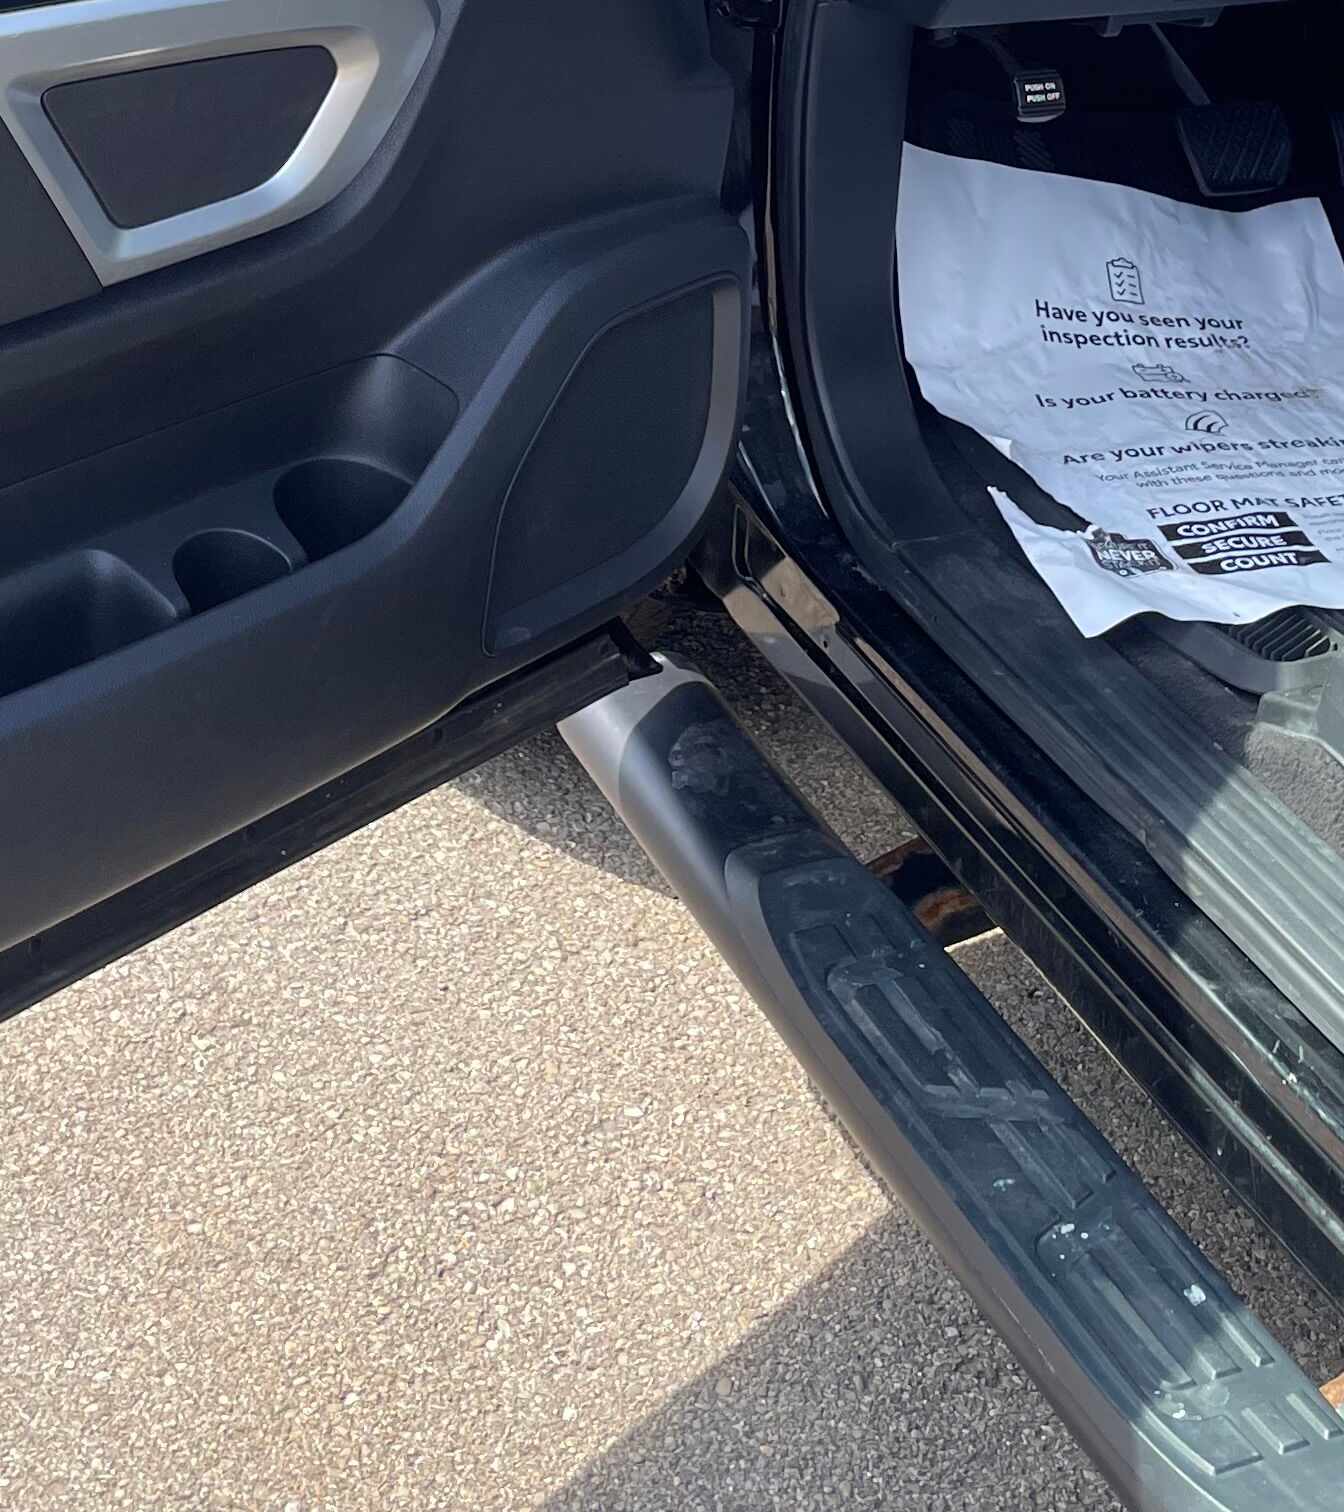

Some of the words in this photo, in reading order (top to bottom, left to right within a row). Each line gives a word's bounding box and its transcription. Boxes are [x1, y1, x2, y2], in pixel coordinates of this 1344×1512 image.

[1035, 299, 1087, 322] Have
[1092, 309, 1134, 327] you
[1139, 314, 1190, 328] seen
[1193, 316, 1243, 330] your
[1040, 324, 1160, 349] inspection
[1164, 334, 1250, 349] results?
[1035, 393, 1057, 408] Is
[1060, 391, 1115, 409] your
[1118, 387, 1207, 402] battery
[1063, 450, 1105, 465] Are
[1110, 444, 1164, 462] your
[1170, 441, 1254, 454] wipers
[1096, 472, 1129, 483] Your
[1134, 462, 1198, 479] Assistant
[1201, 461, 1254, 472] Service
[1255, 458, 1317, 469] Manager
[1136, 479, 1169, 489] with
[1170, 473, 1213, 486] these
[1216, 470, 1287, 481] questions
[1288, 469, 1316, 477] and
[1146, 499, 1228, 519] FLOOR
[1231, 496, 1279, 509] MAT
[1176, 514, 1280, 537] CONFIRM
[1096, 549, 1156, 561] NEVER
[1202, 535, 1287, 554] SECURE
[1219, 552, 1299, 572] COUNT
